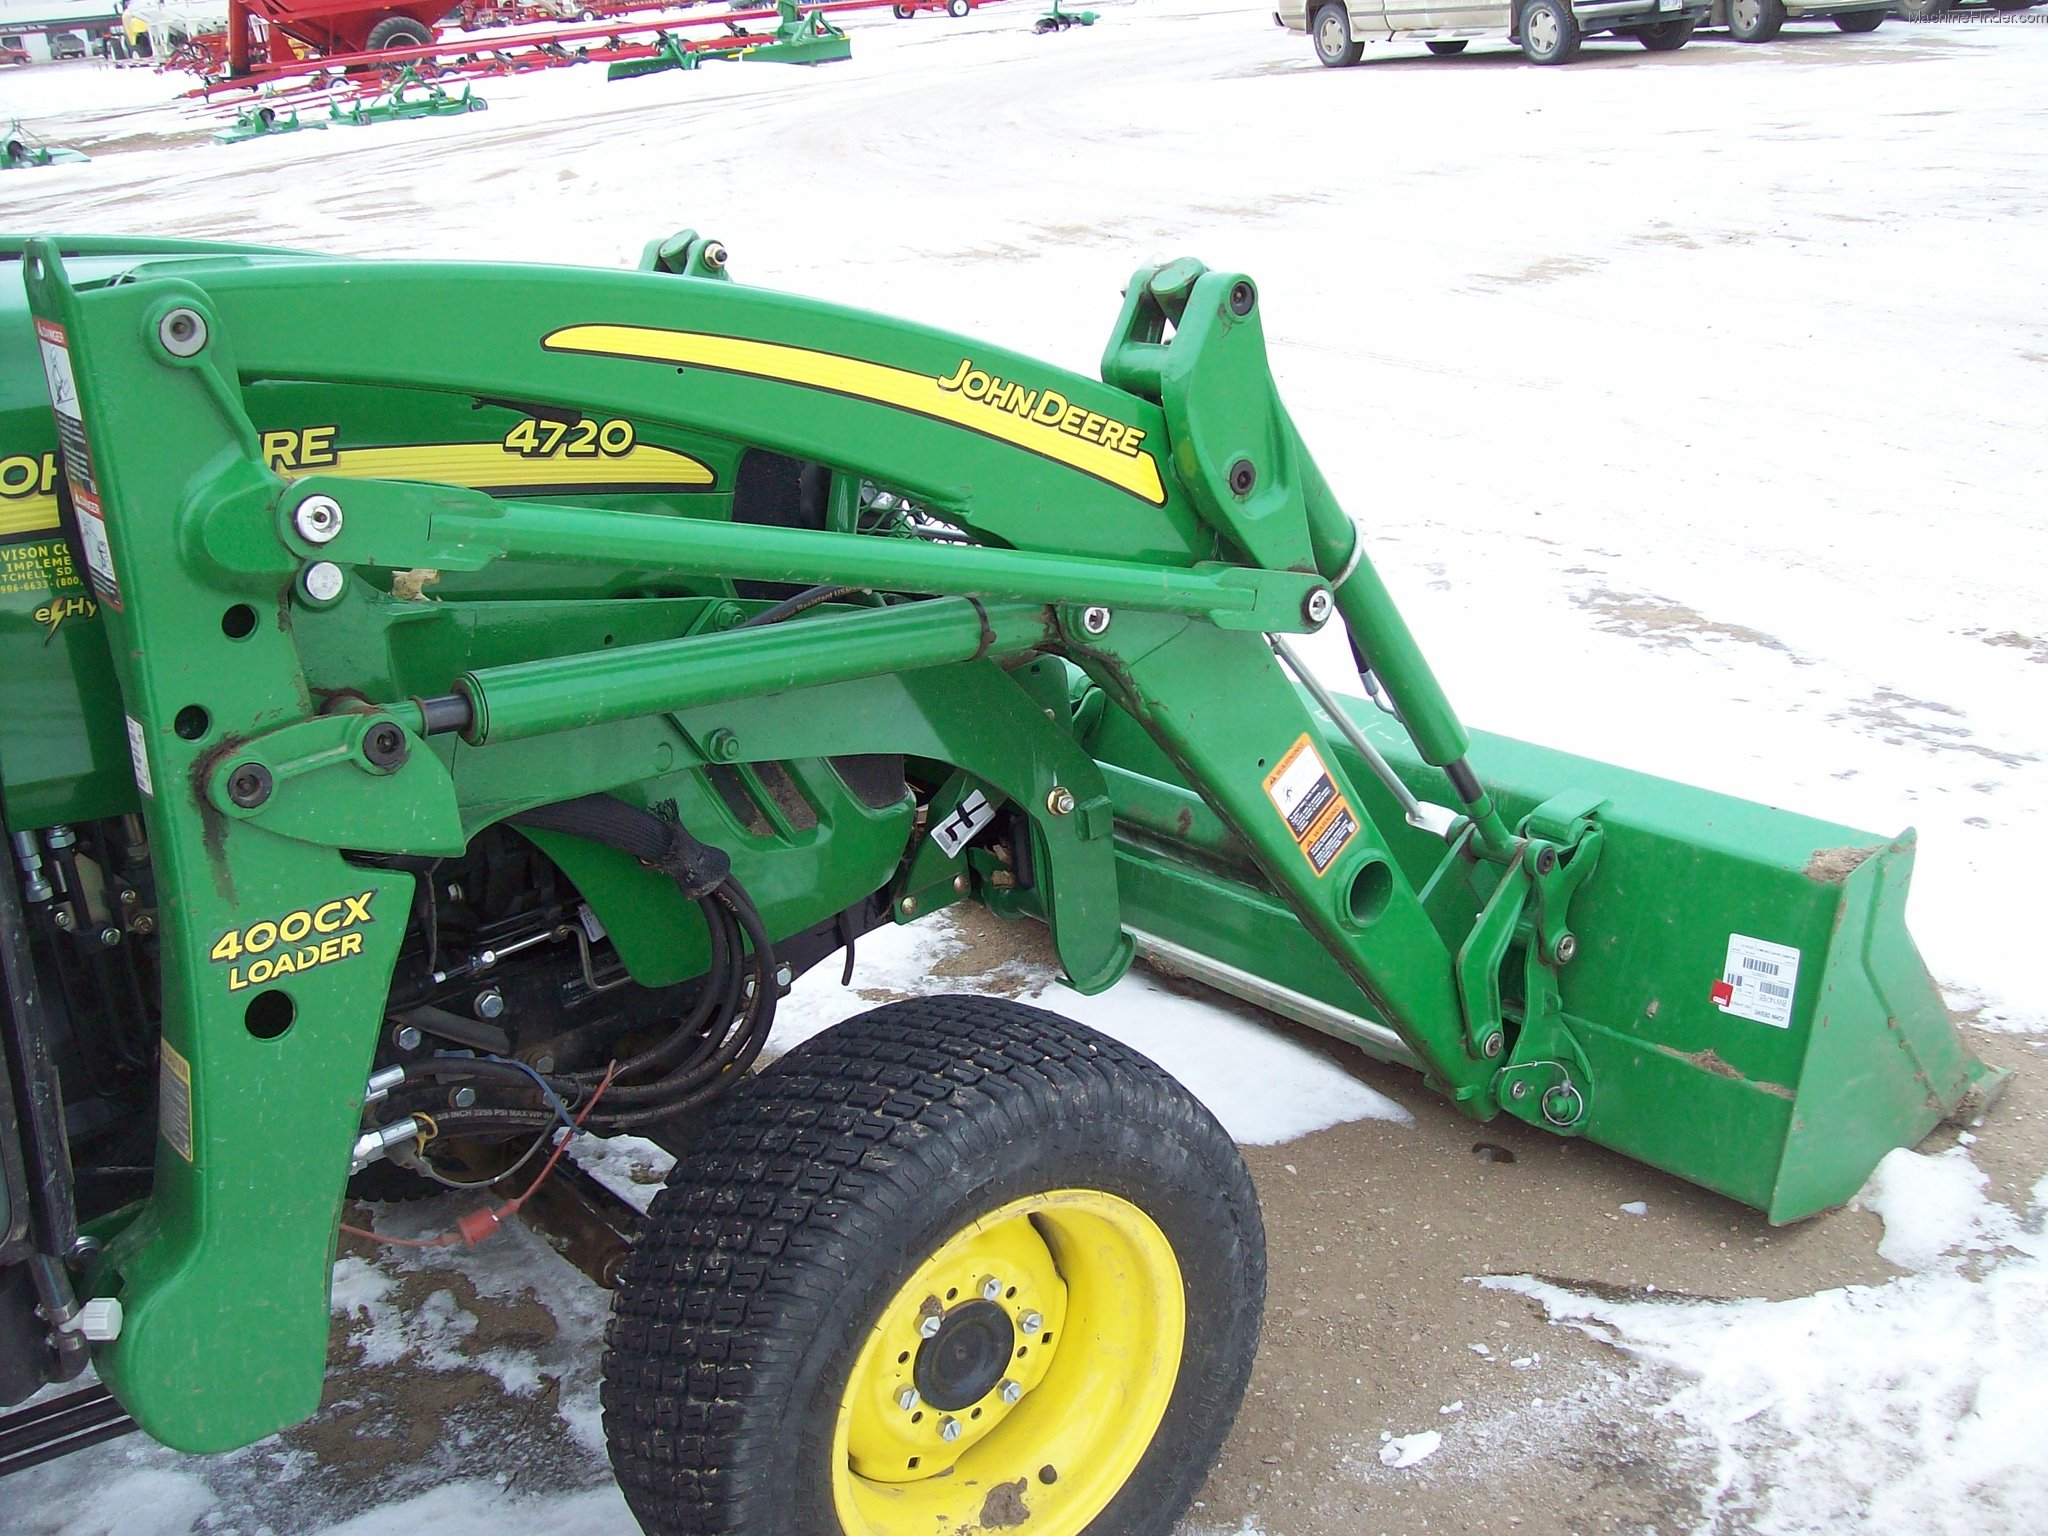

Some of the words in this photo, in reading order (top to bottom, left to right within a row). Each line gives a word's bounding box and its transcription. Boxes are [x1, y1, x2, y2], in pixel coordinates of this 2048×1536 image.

[937, 358, 1038, 419] JOHN
[1031, 388, 1147, 458] DEERE
[504, 418, 636, 455] 4720
[56, 567, 73, 577] SD
[1276, 742, 1305, 777] WARNING
[1313, 804, 1342, 839] WARNING
[211, 892, 373, 961] 400CX
[229, 932, 363, 991] LOADER
[450, 1110, 472, 1118] INCH
[494, 1108, 508, 1117] PSI
[508, 1109, 528, 1118] MAX
